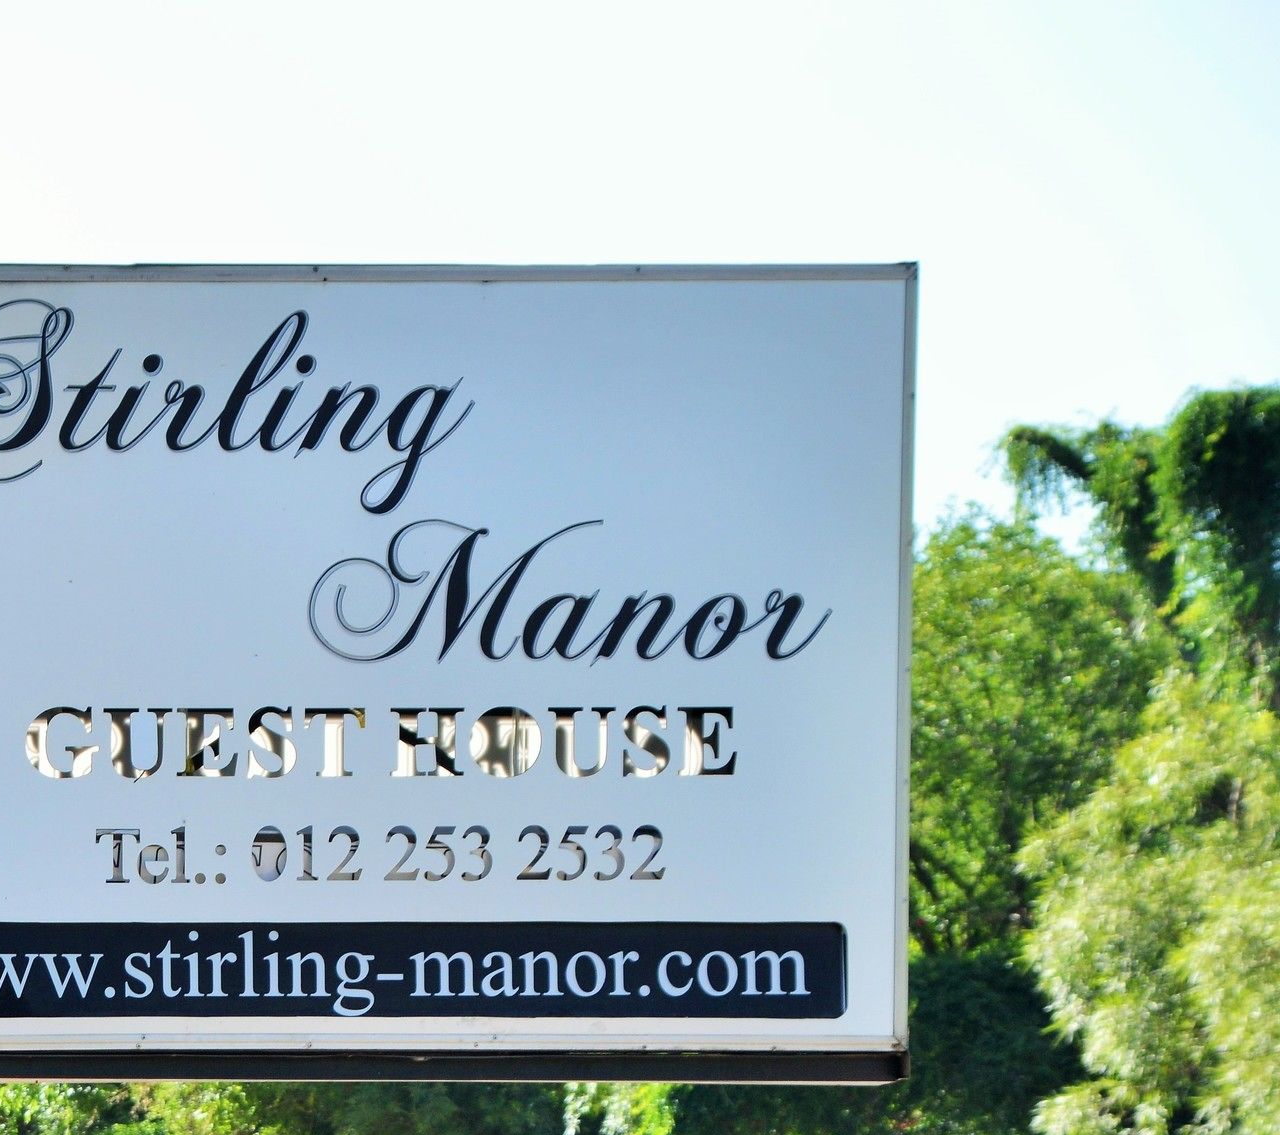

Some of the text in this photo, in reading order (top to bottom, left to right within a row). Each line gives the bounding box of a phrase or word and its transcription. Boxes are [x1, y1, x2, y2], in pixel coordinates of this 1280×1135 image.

[307, 518, 832, 664] Manor
[24, 705, 737, 780] GUEST HOUSE
[96, 819, 667, 885] Tel.: 012 253 2532
